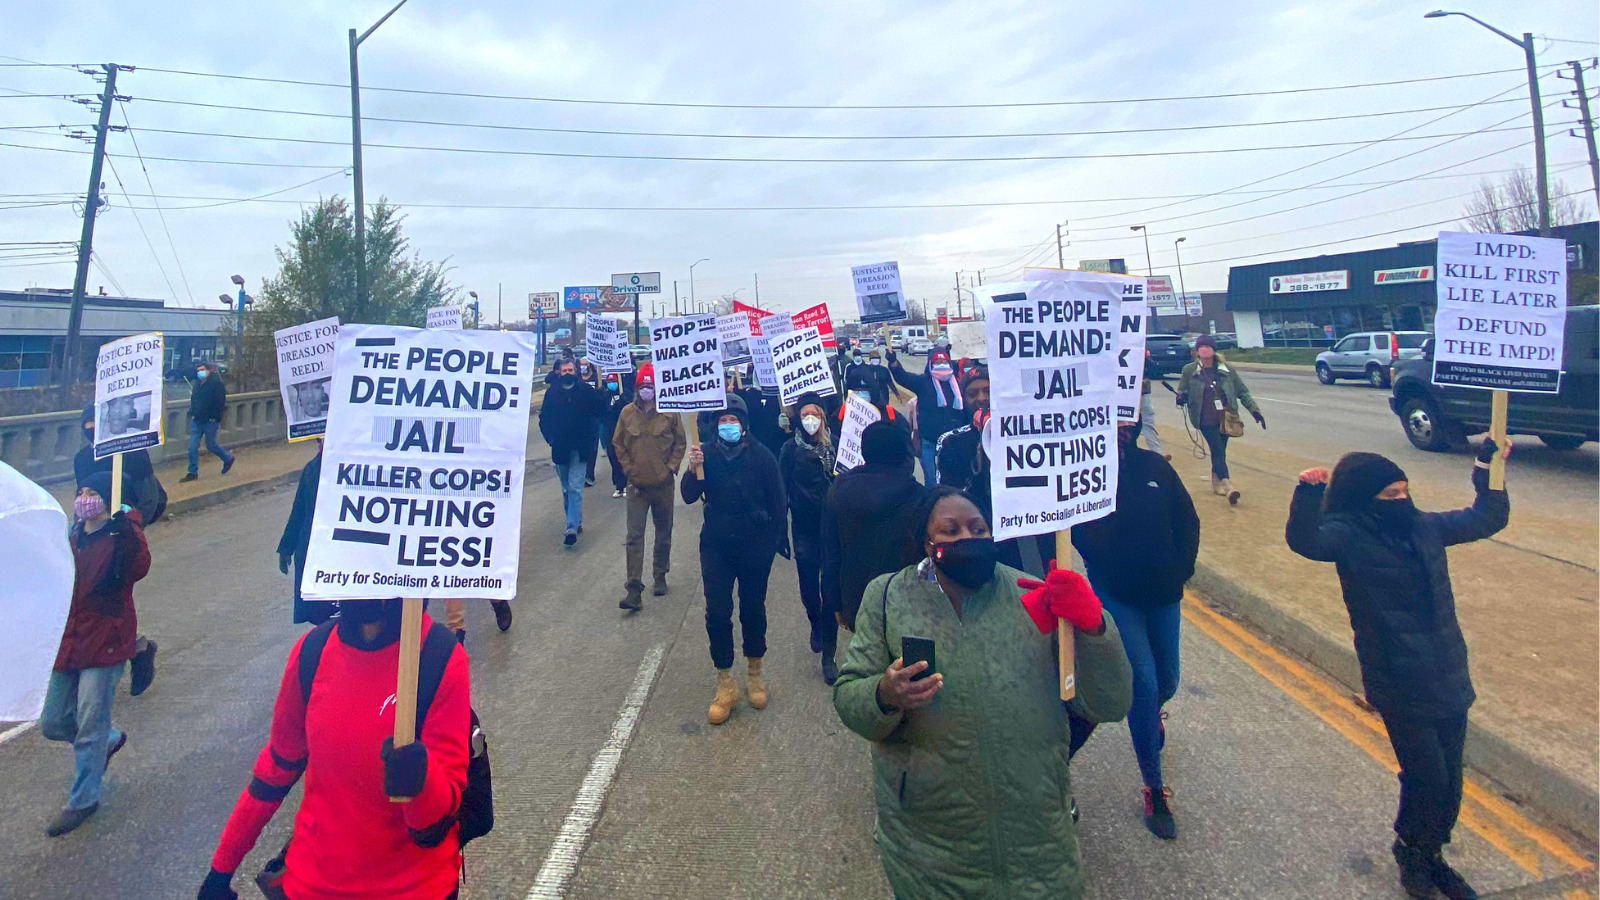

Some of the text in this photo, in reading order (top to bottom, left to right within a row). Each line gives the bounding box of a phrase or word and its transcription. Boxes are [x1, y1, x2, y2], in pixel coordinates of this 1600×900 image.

[1474, 242, 1536, 260] IMPD:
[852, 266, 882, 276] JUSTICE
[857, 274, 895, 284] DREASJON
[1444, 263, 1560, 284] KILL FIRST
[613, 285, 658, 293] DriveTime
[866, 283, 888, 291] REED!
[1122, 284, 1143, 294] HE
[1446, 286, 1558, 308] LIE LATER
[1002, 301, 1109, 323] THE PEOPLE
[653, 318, 715, 341] STOP THE
[719, 323, 745, 332] REASJON
[1120, 315, 1141, 332] N
[1457, 316, 1547, 337] DEFUND
[276, 324, 339, 348] JUSTICE FOR
[773, 329, 817, 357] STOP THE
[999, 329, 1111, 358] DEMAND:
[96, 340, 160, 365] JUSTICE FOR
[281, 342, 335, 363] DREASJON
[655, 338, 717, 361] WAR ON
[775, 344, 822, 371] WAR ON
[1444, 339, 1555, 361] THE IMPD!
[100, 356, 153, 380] DREASJON
[291, 361, 324, 377] REED!
[362, 347, 519, 375] THE PEOPLE
[662, 361, 714, 383] BLACK
[782, 361, 823, 385] BLACK
[1033, 368, 1083, 400] JAIL
[1471, 376, 1510, 385] SOCIALISM
[107, 376, 139, 393] REED!
[349, 376, 519, 410] DEMAND:
[659, 378, 720, 399] AMERICA!
[784, 372, 829, 397] AMERICA!
[850, 411, 867, 427] DREA
[1000, 405, 1110, 437] KILLER COPS!
[385, 419, 464, 453] JAIL
[847, 439, 861, 453] DEF
[841, 447, 855, 464] THE
[1007, 434, 1106, 471] NOTHING
[336, 463, 511, 492] KILLER COPS!
[1057, 465, 1107, 502] LESS!
[339, 495, 495, 528] NOTHING
[1001, 497, 1112, 528] Party for Socialism & Liberation
[397, 535, 492, 567] LESS!
[315, 570, 502, 589] Party for Socialism & Liberation
